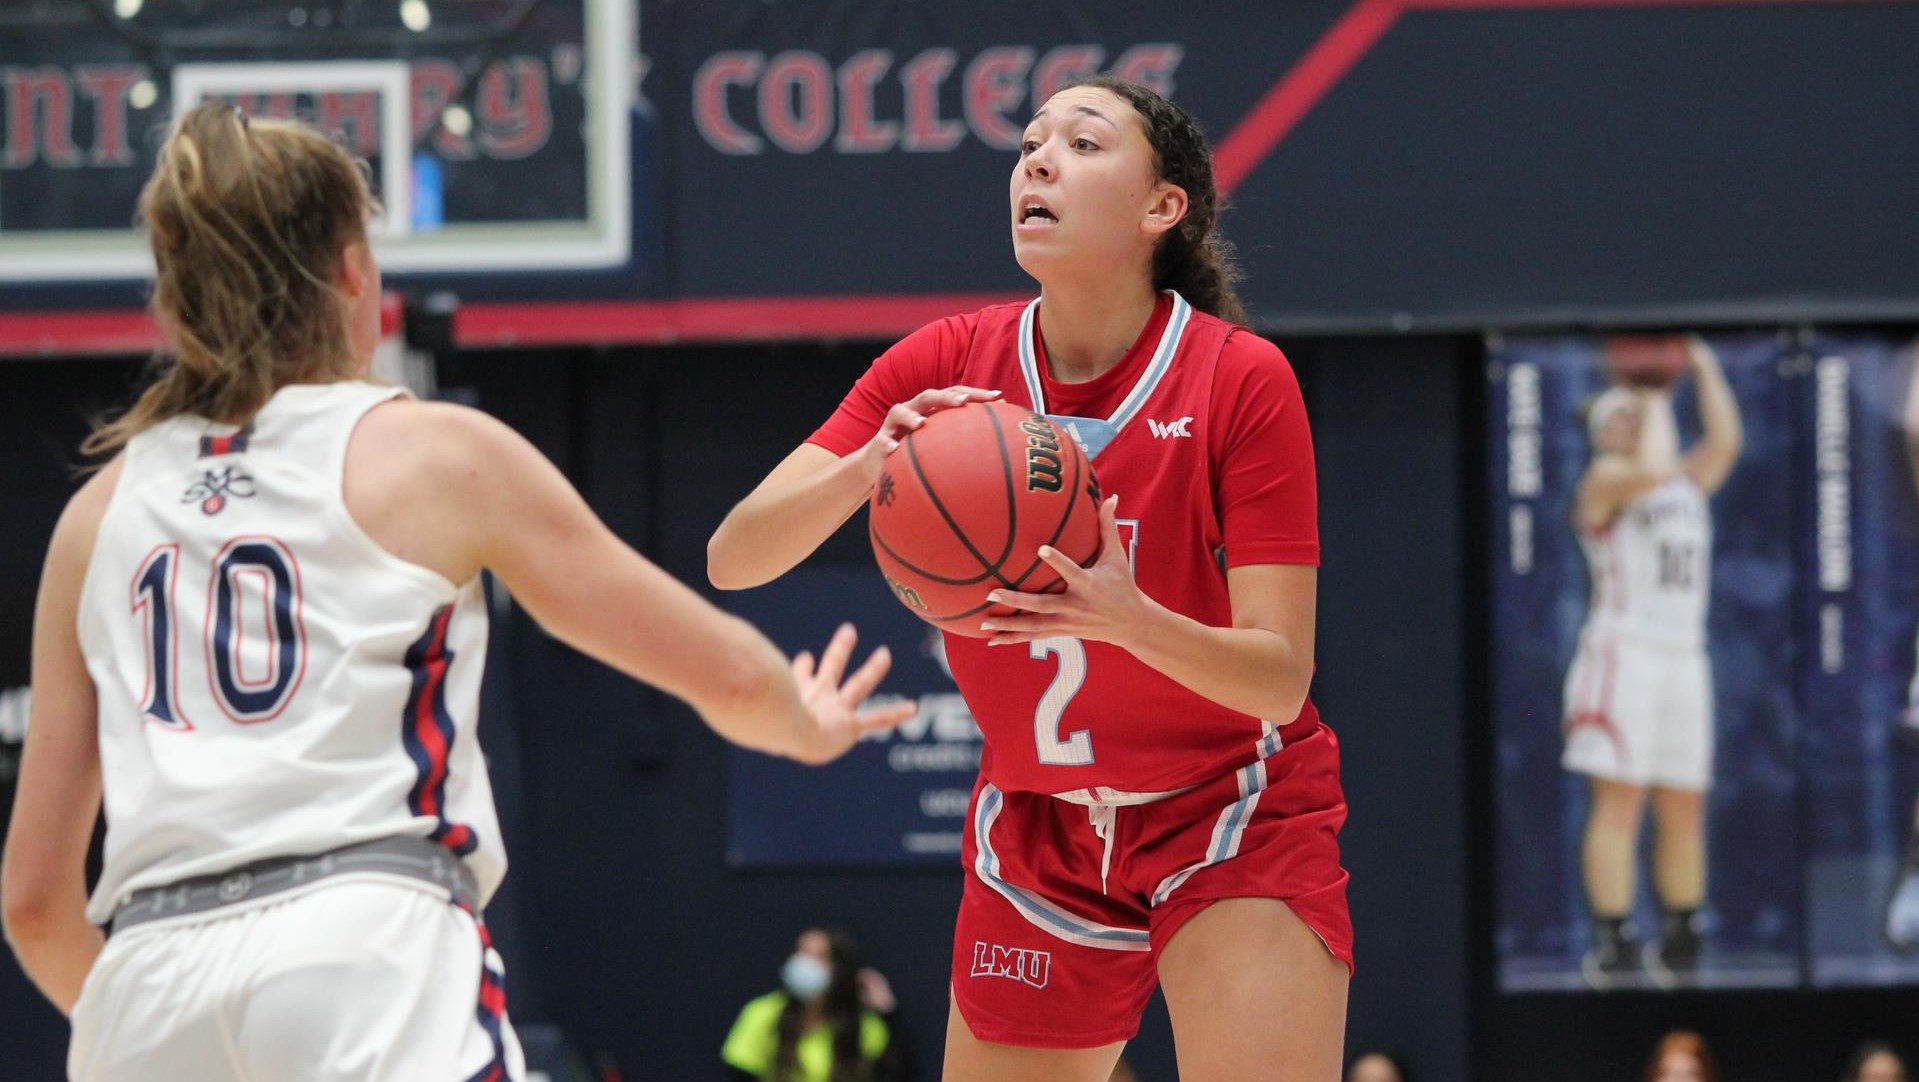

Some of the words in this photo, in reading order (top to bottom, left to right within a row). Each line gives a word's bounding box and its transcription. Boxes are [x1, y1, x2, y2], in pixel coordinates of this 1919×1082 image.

[130, 535, 307, 732] 10
[1029, 636, 1096, 766] 2
[970, 940, 1052, 990] LMU
